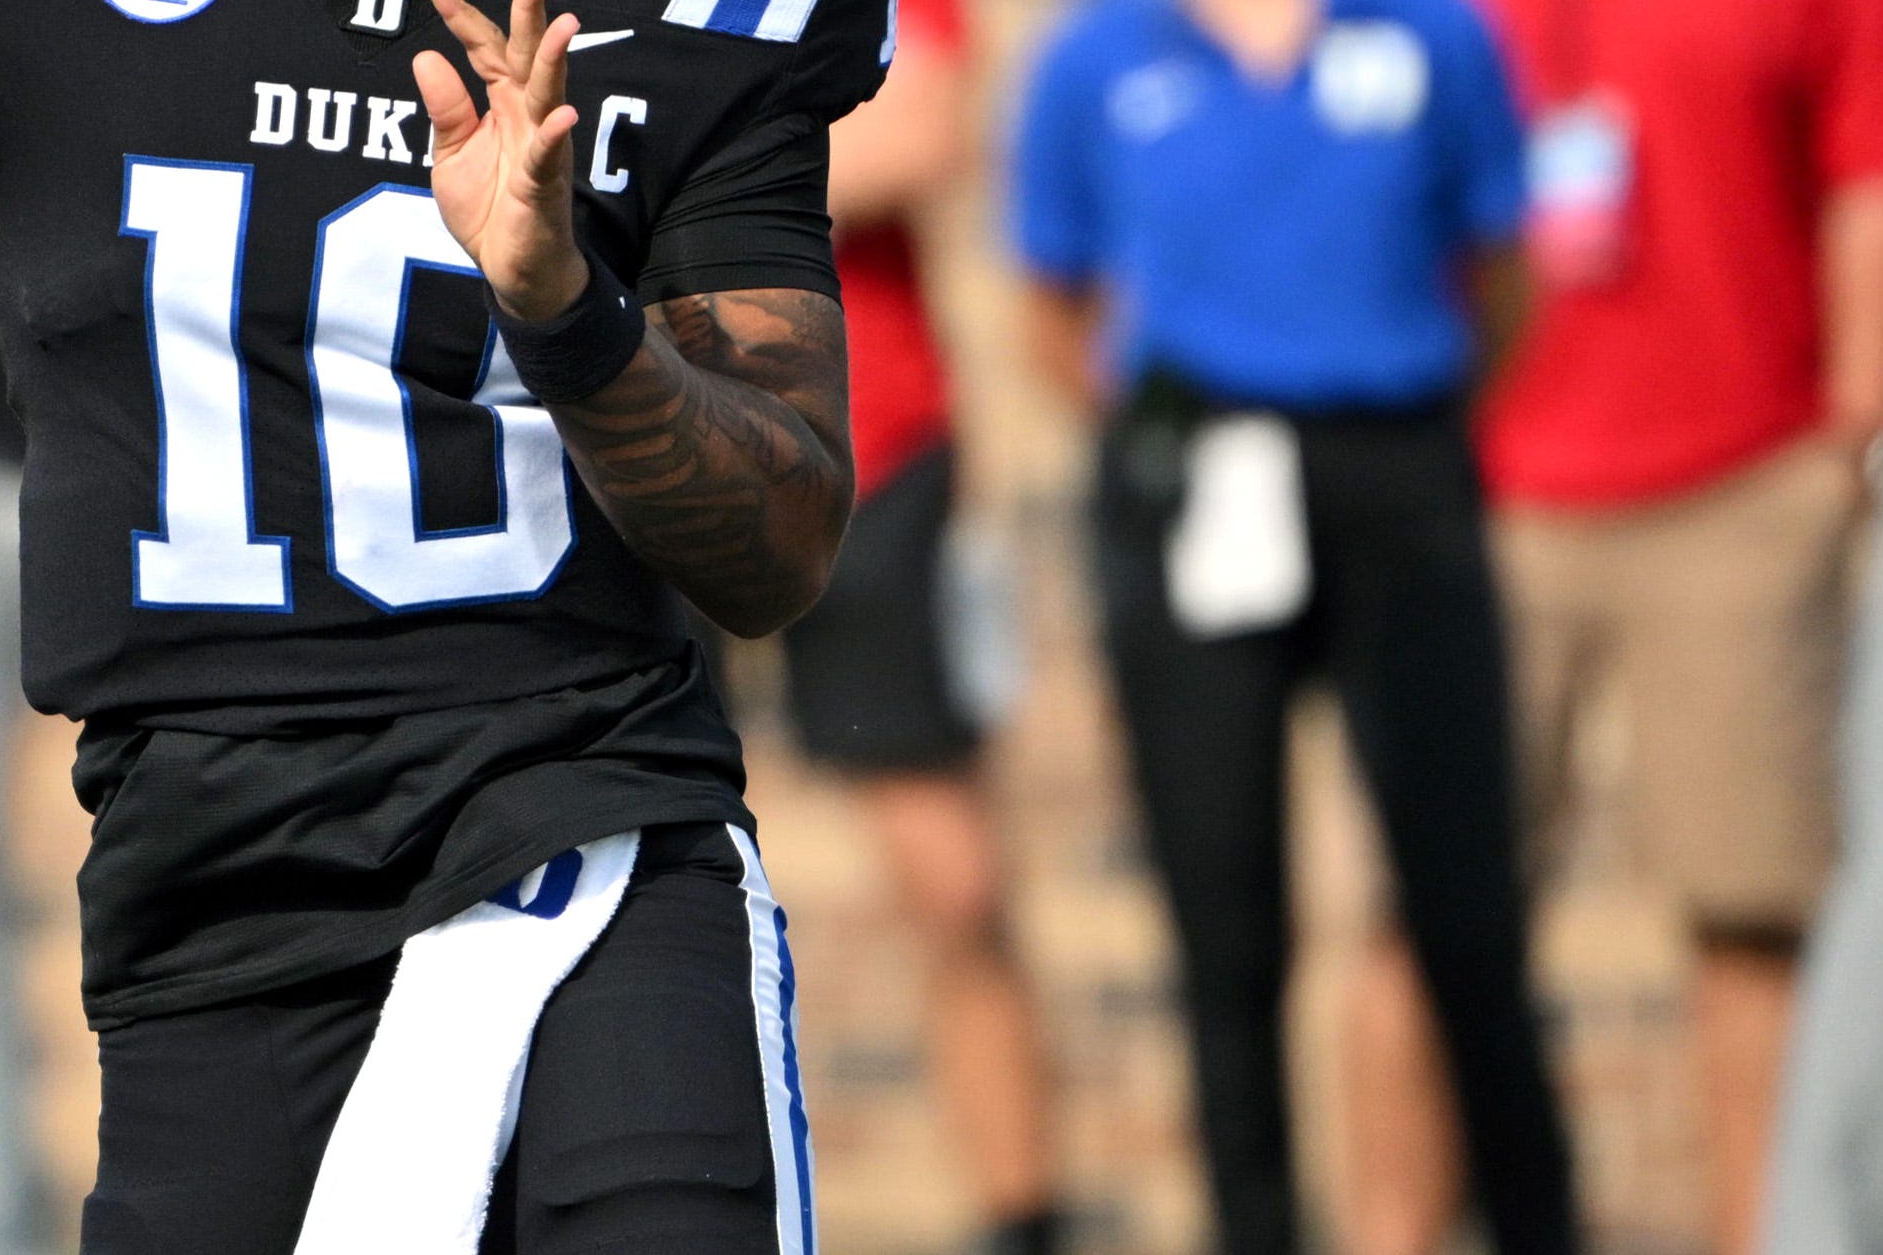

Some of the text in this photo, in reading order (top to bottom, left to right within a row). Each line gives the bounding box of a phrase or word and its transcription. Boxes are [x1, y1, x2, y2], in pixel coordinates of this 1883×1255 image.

[250, 81, 434, 169] DUK
[589, 95, 648, 193] C
[118, 154, 579, 616] 10
